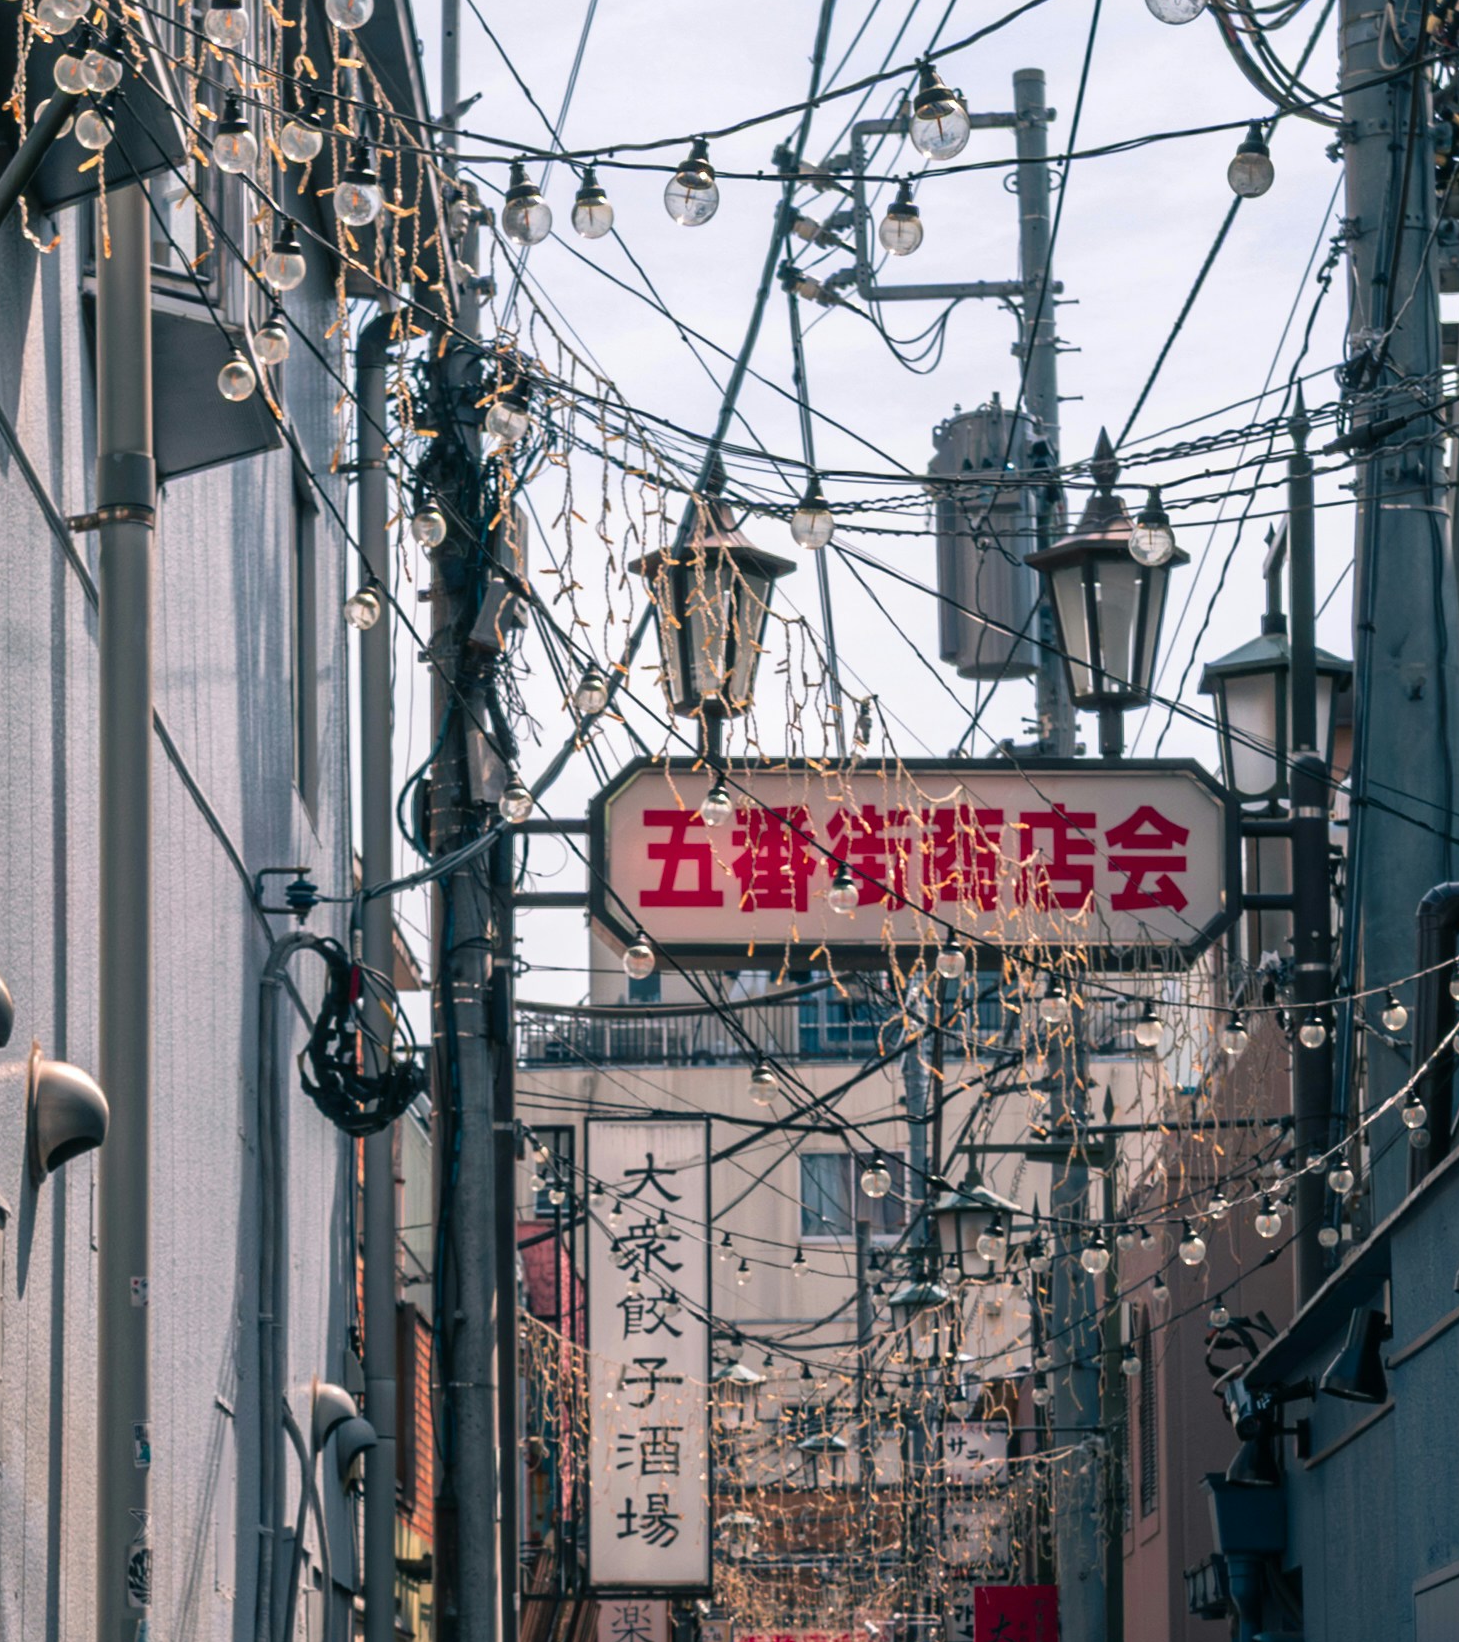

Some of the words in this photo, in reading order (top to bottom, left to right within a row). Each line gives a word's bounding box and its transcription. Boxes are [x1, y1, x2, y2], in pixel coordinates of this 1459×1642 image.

[639, 802, 1190, 913] 五番街商店会
[615, 1152, 684, 1548] 大衆餃子酒場
